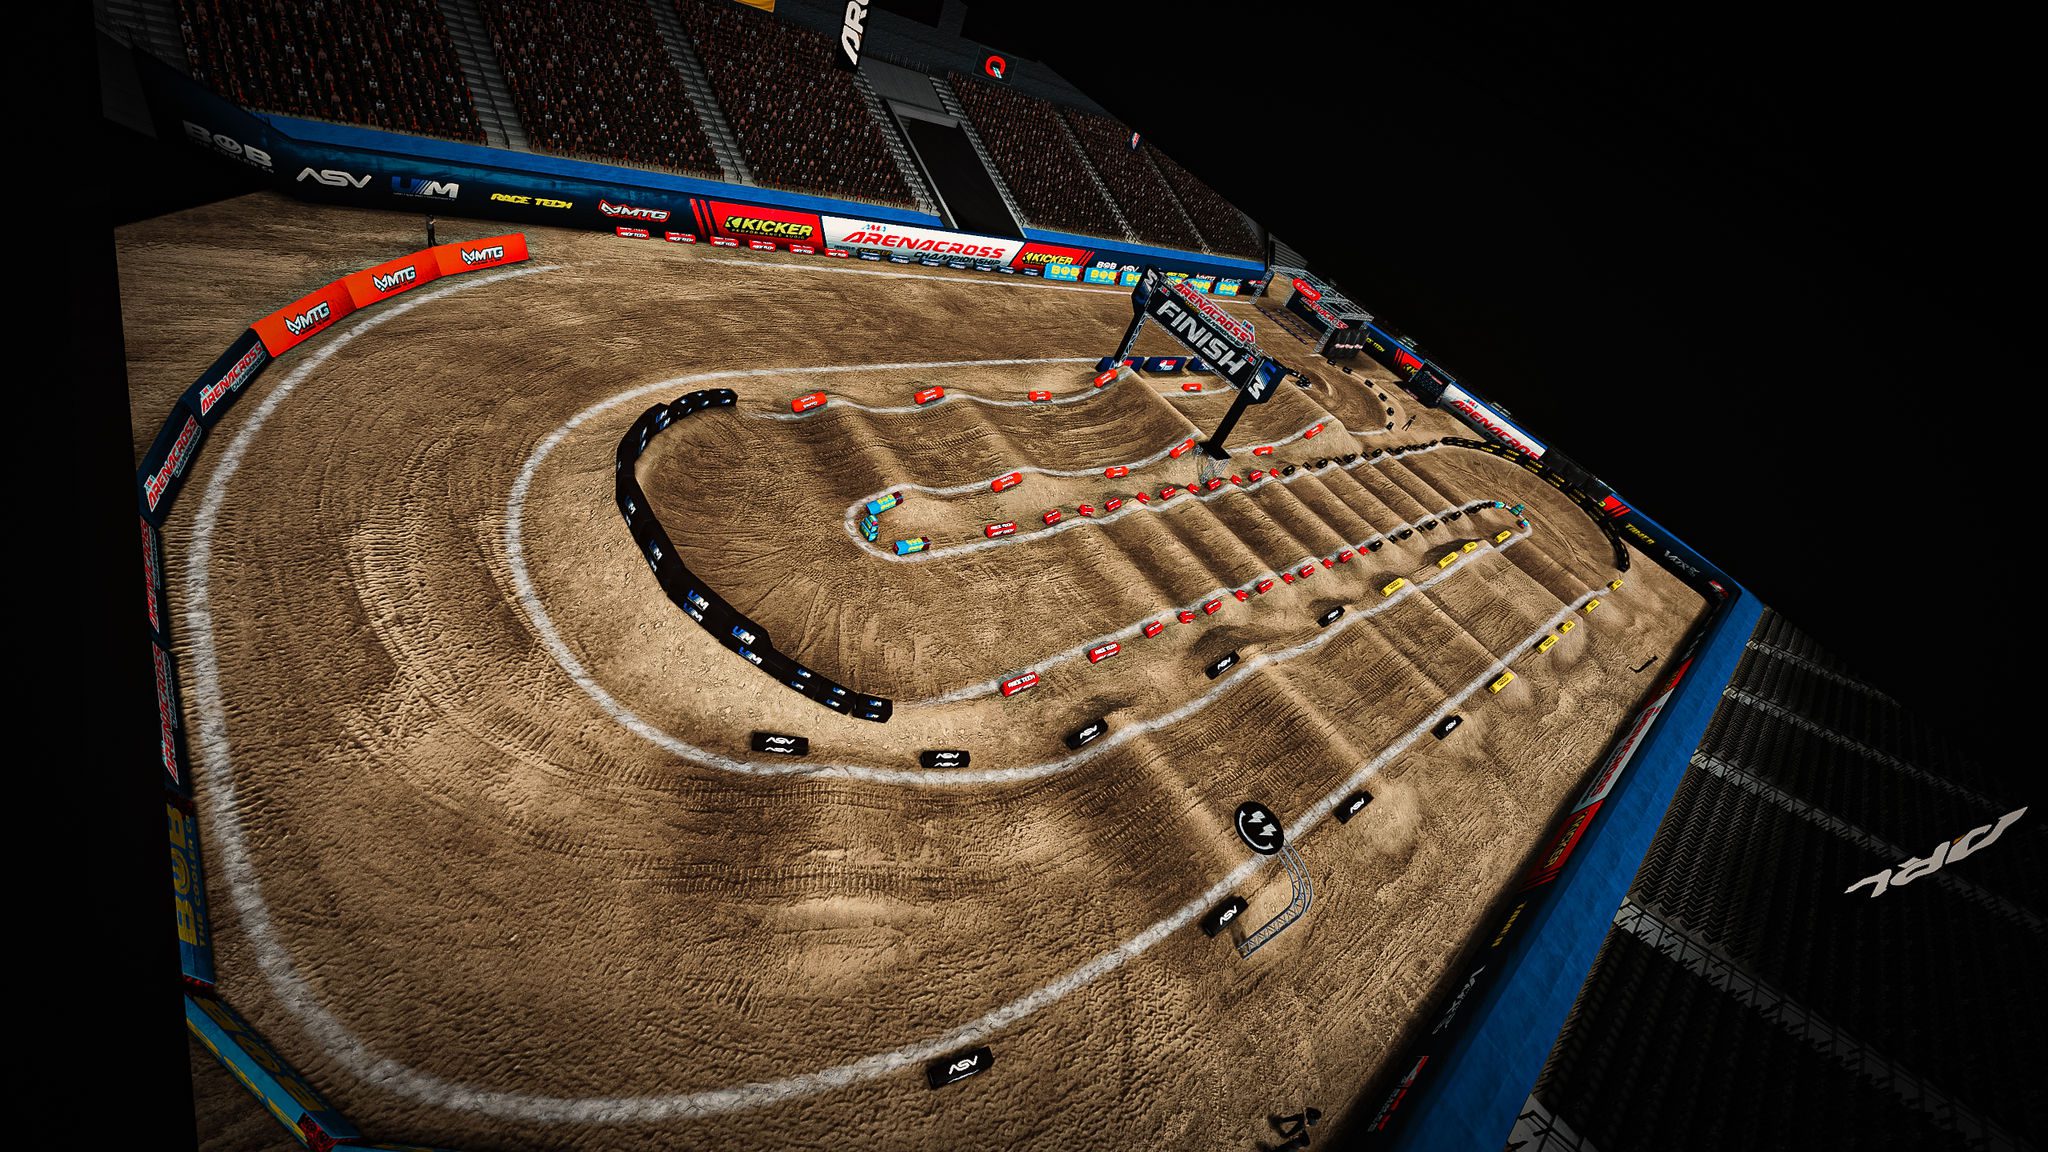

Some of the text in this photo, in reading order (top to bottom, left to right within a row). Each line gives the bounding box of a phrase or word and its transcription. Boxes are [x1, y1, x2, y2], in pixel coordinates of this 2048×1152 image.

[841, 0, 869, 66] AR
[296, 167, 372, 188] ASV
[490, 193, 573, 209] RACE TECH
[742, 218, 813, 236] KICKER
[474, 246, 504, 262] MTG
[841, 231, 1006, 259] ARENACROSS
[913, 251, 1001, 266] CHAMPIONSHIP
[1031, 253, 1074, 265] KICKER
[386, 265, 416, 288] MTG
[299, 302, 330, 331] MTG
[1173, 283, 1249, 344] ARENACROSS
[1156, 299, 1247, 376] FINISH
[201, 340, 264, 416] ARENACROSS
[145, 414, 198, 512] ARENACROSS
[766, 736, 795, 745] ASV
[1079, 724, 1098, 740] ASV
[934, 751, 959, 760] ASV
[1219, 905, 1238, 926] ASV
[948, 1054, 979, 1075] ASV
